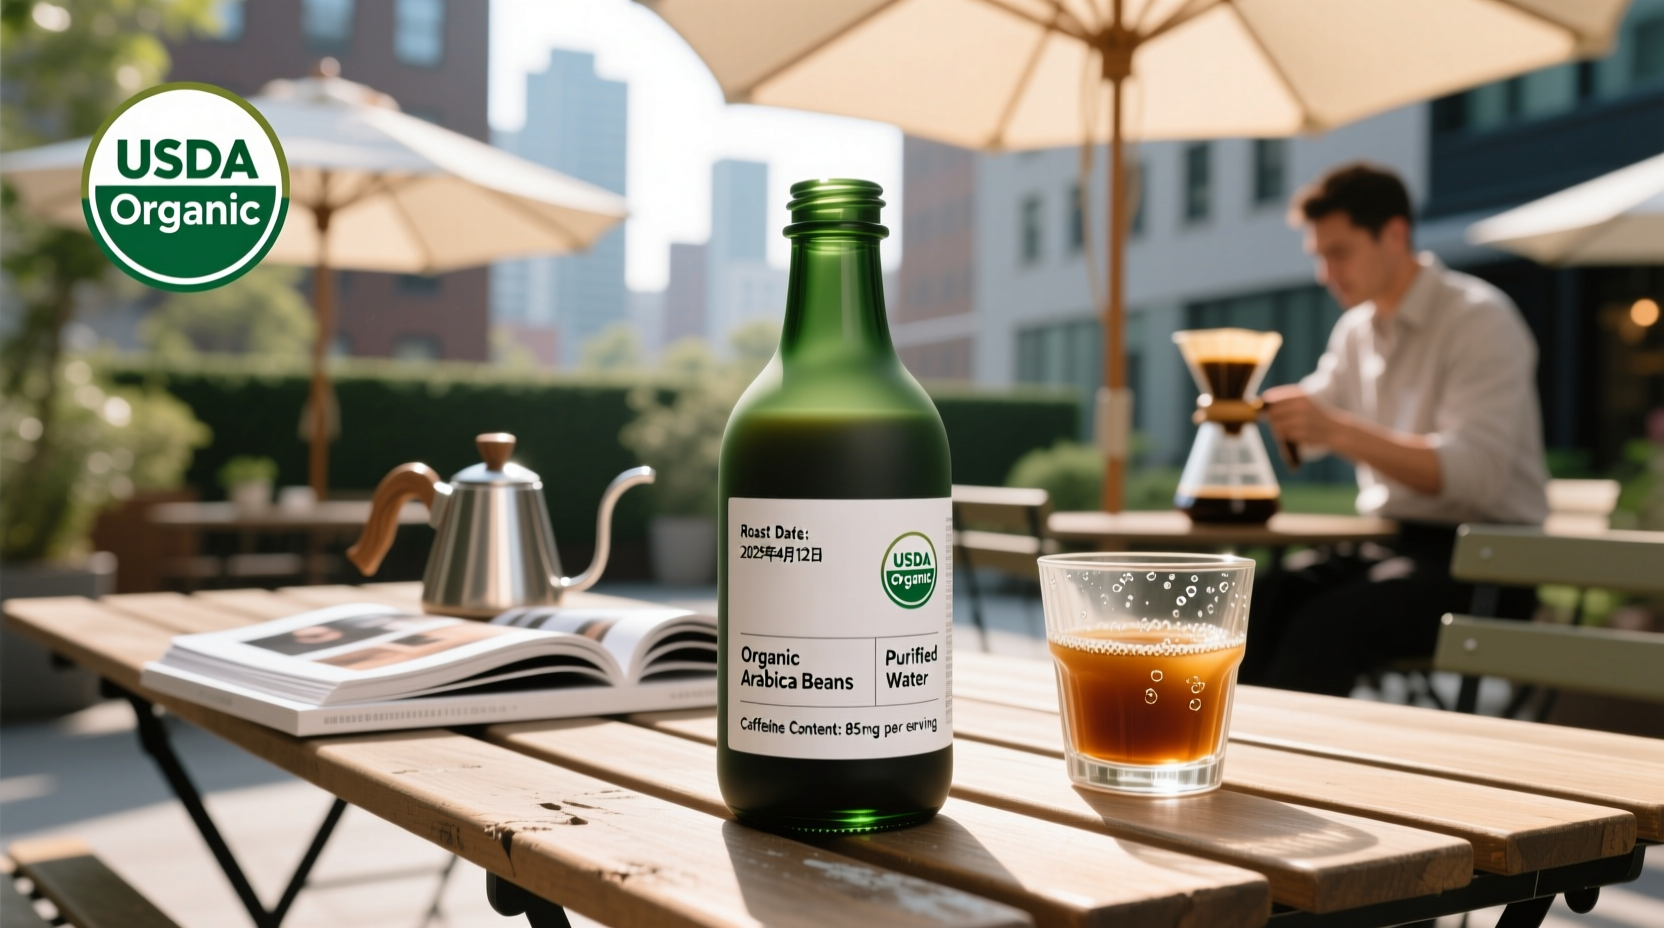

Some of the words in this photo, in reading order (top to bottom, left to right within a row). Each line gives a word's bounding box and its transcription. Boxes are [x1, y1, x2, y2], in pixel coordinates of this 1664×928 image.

[740, 523, 771, 539] Roast
[775, 525, 809, 541] Date:
[893, 551, 932, 568] USDA
[741, 646, 800, 669] Organic
[885, 644, 938, 666] Purified
[740, 669, 797, 689] Arabica
[801, 672, 854, 690] Beans
[886, 671, 929, 689] Water
[740, 716, 786, 734] Caffeine
[789, 720, 842, 736] Content:
[845, 722, 880, 739] 85mg
[884, 723, 904, 738] per
